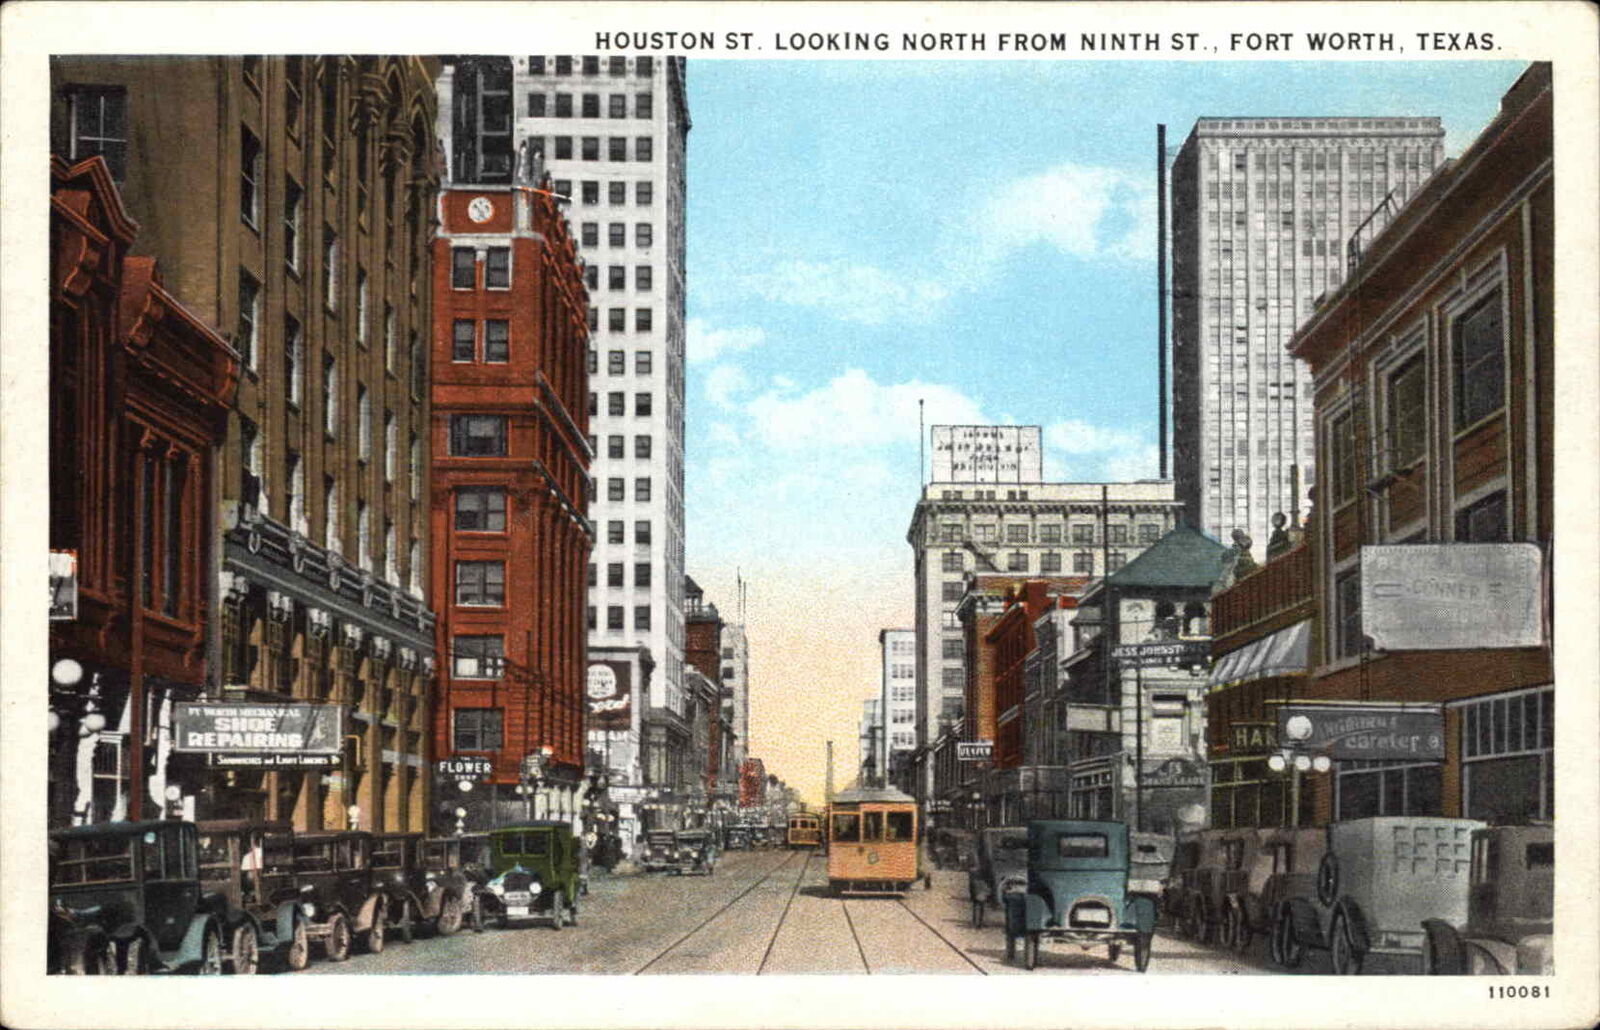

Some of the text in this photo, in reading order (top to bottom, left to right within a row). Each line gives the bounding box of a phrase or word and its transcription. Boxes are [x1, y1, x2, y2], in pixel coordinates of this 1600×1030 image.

[1111, 647, 1138, 657] JESS
[214, 717, 277, 732] SHOE
[187, 732, 304, 747] REPAIRING
[439, 761, 491, 773] FLOWER
